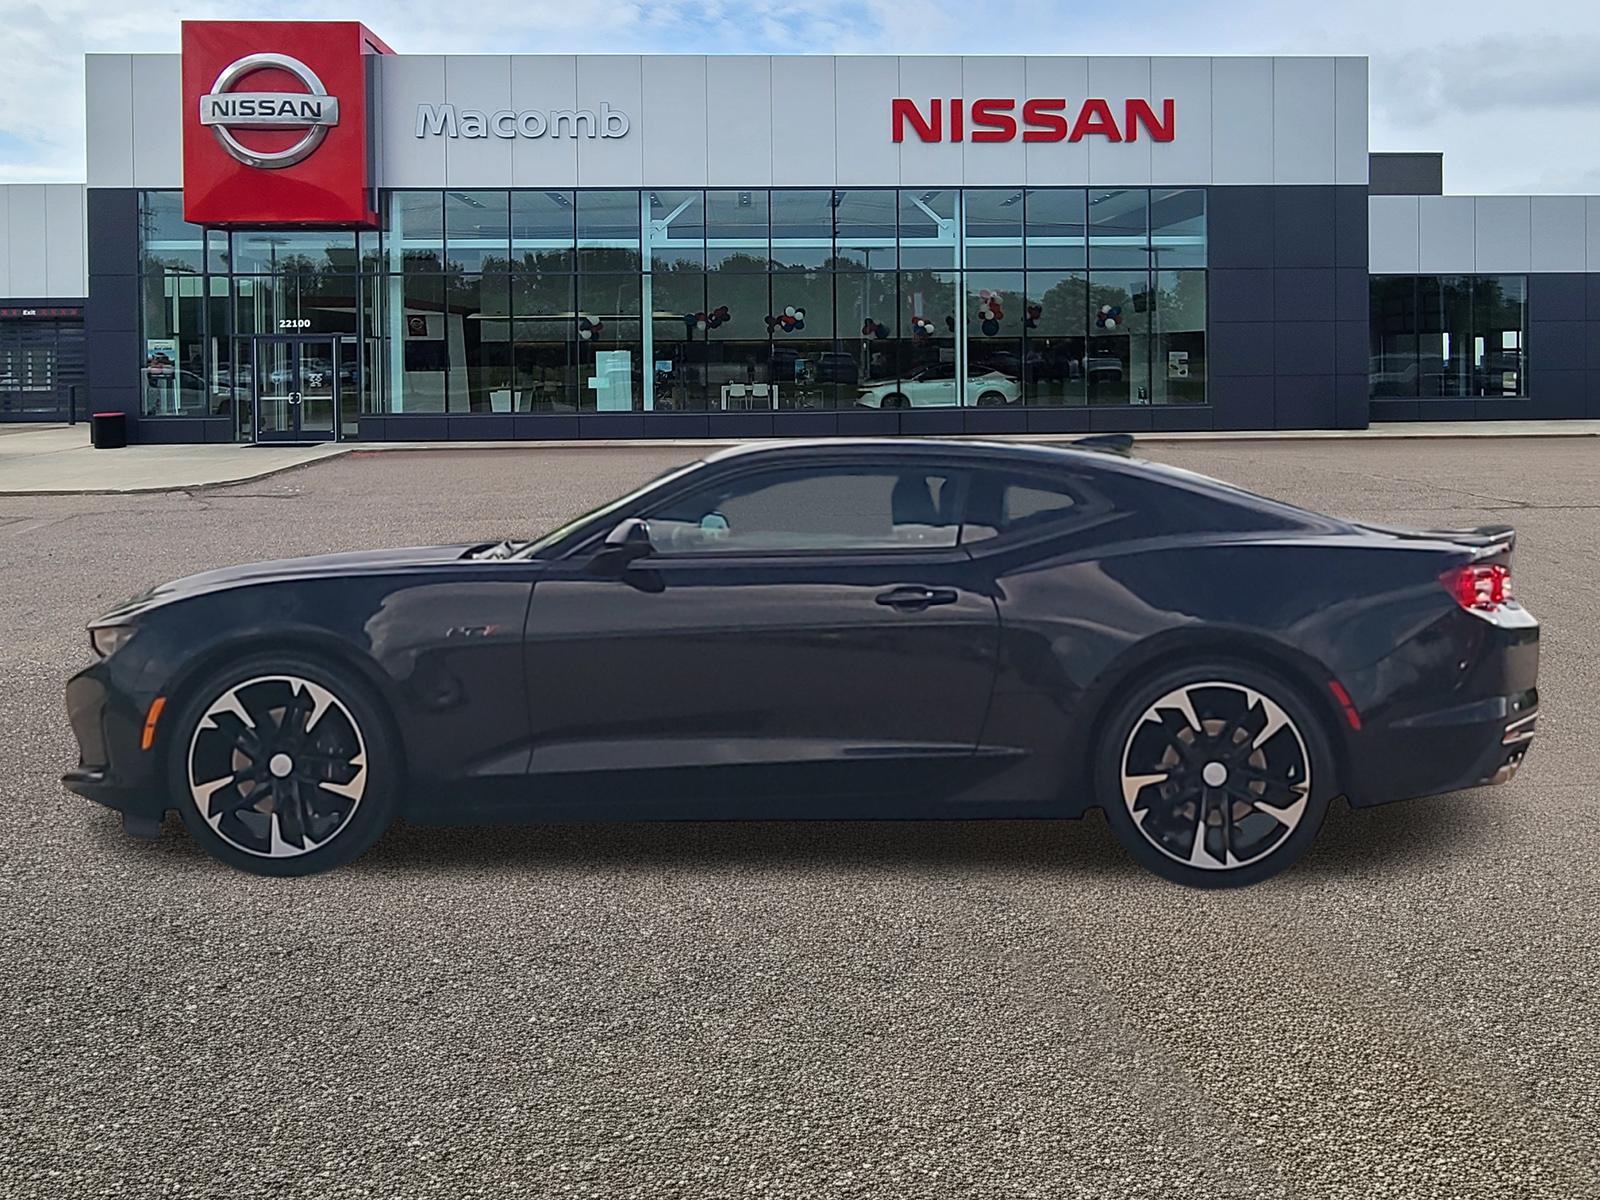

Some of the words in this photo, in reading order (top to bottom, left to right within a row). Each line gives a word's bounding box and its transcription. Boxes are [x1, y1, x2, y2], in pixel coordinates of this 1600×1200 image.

[211, 100, 322, 117] NISSAN
[415, 101, 630, 138] Macomb
[892, 98, 1175, 142] NISSAN
[279, 319, 311, 328] 22100
